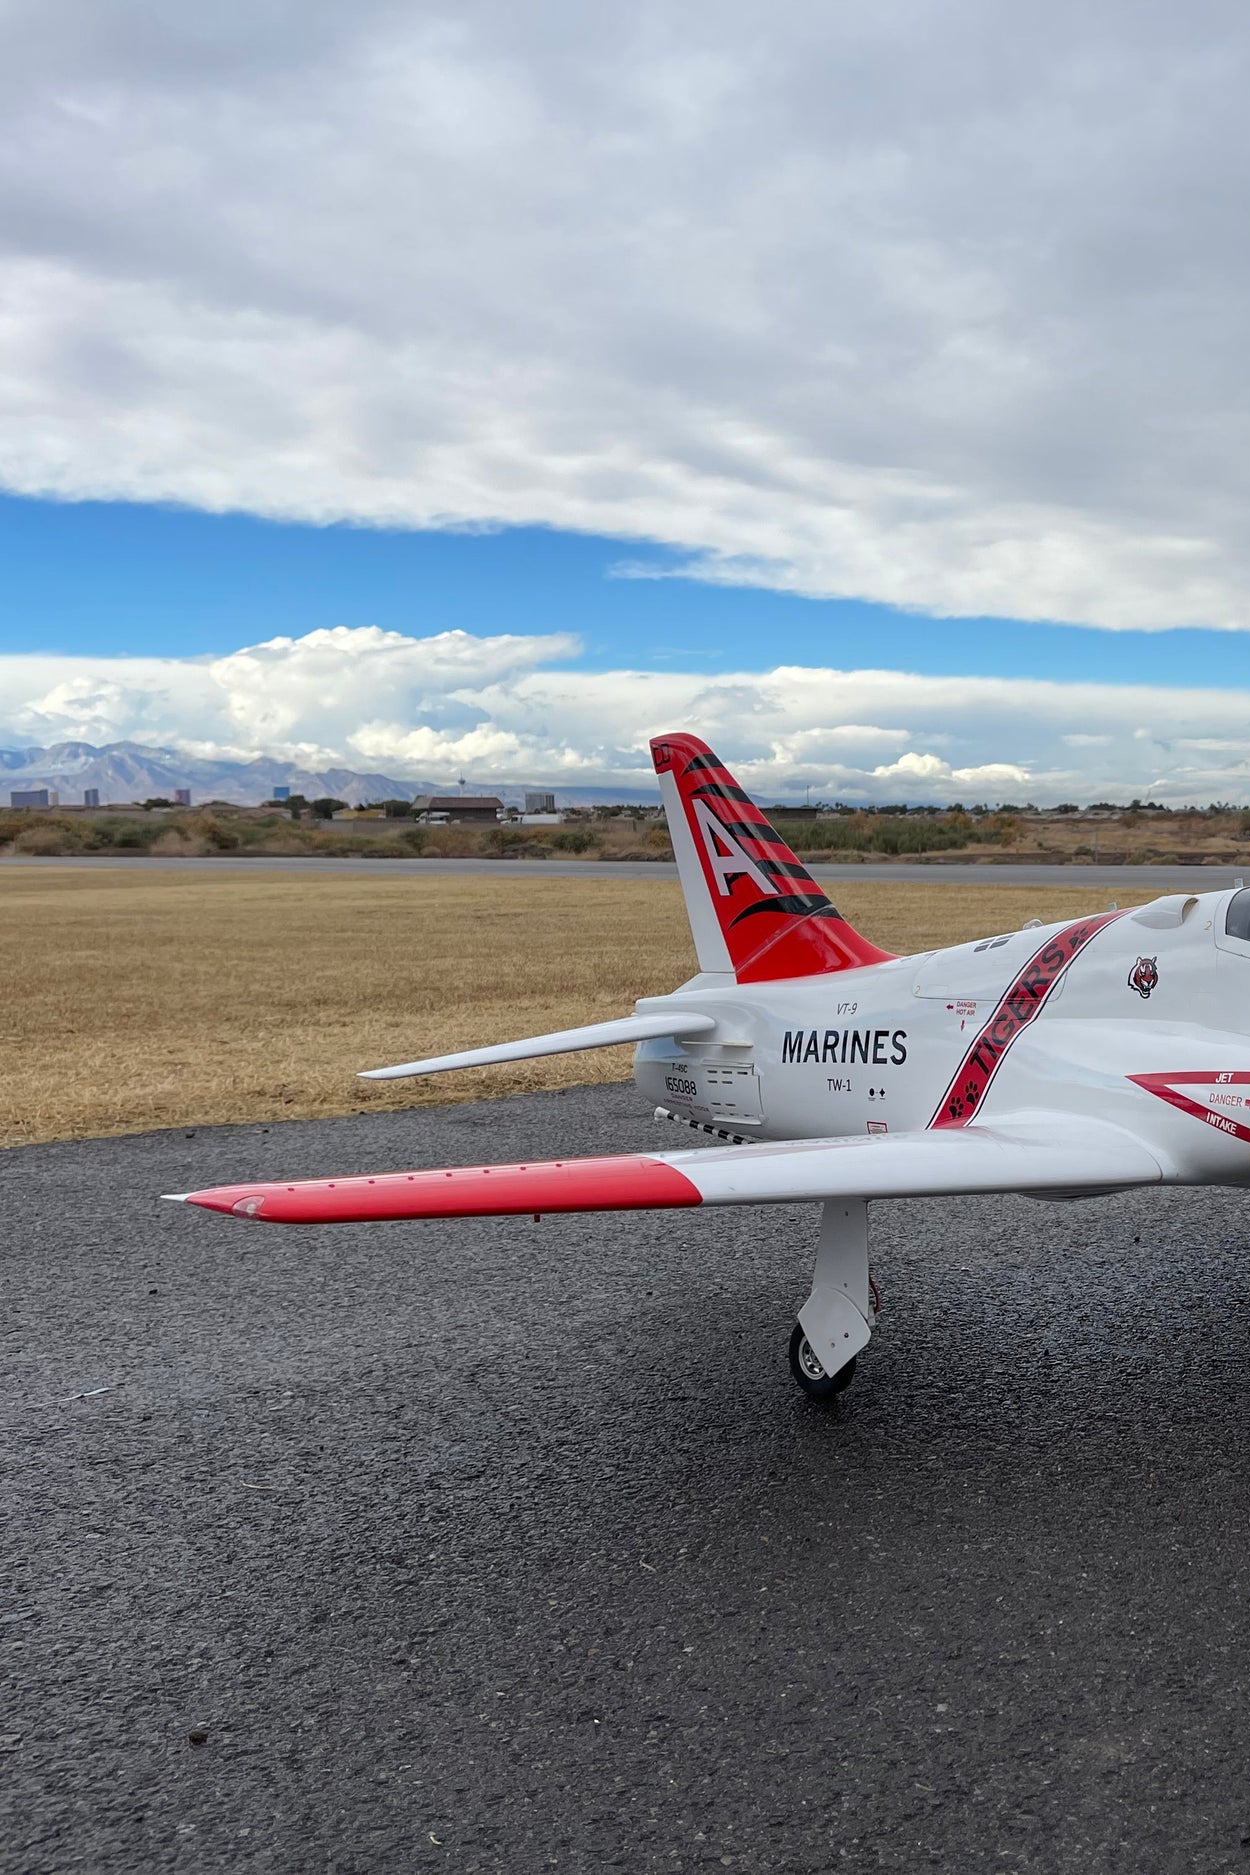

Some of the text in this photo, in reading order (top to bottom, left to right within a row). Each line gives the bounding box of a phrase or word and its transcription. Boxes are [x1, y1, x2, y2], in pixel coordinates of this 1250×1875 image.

[692, 798, 781, 896] A
[837, 1002, 858, 1015] VT-9
[969, 942, 1066, 1076] TIGERS
[782, 1030, 907, 1065] MARINES
[672, 1063, 688, 1073] T-45C
[665, 1075, 697, 1096] 165088
[827, 1078, 852, 1091] TW-1
[1215, 1072, 1235, 1084] JET
[1209, 1092, 1243, 1107] DANGER
[1206, 1111, 1238, 1135] INTAKE
